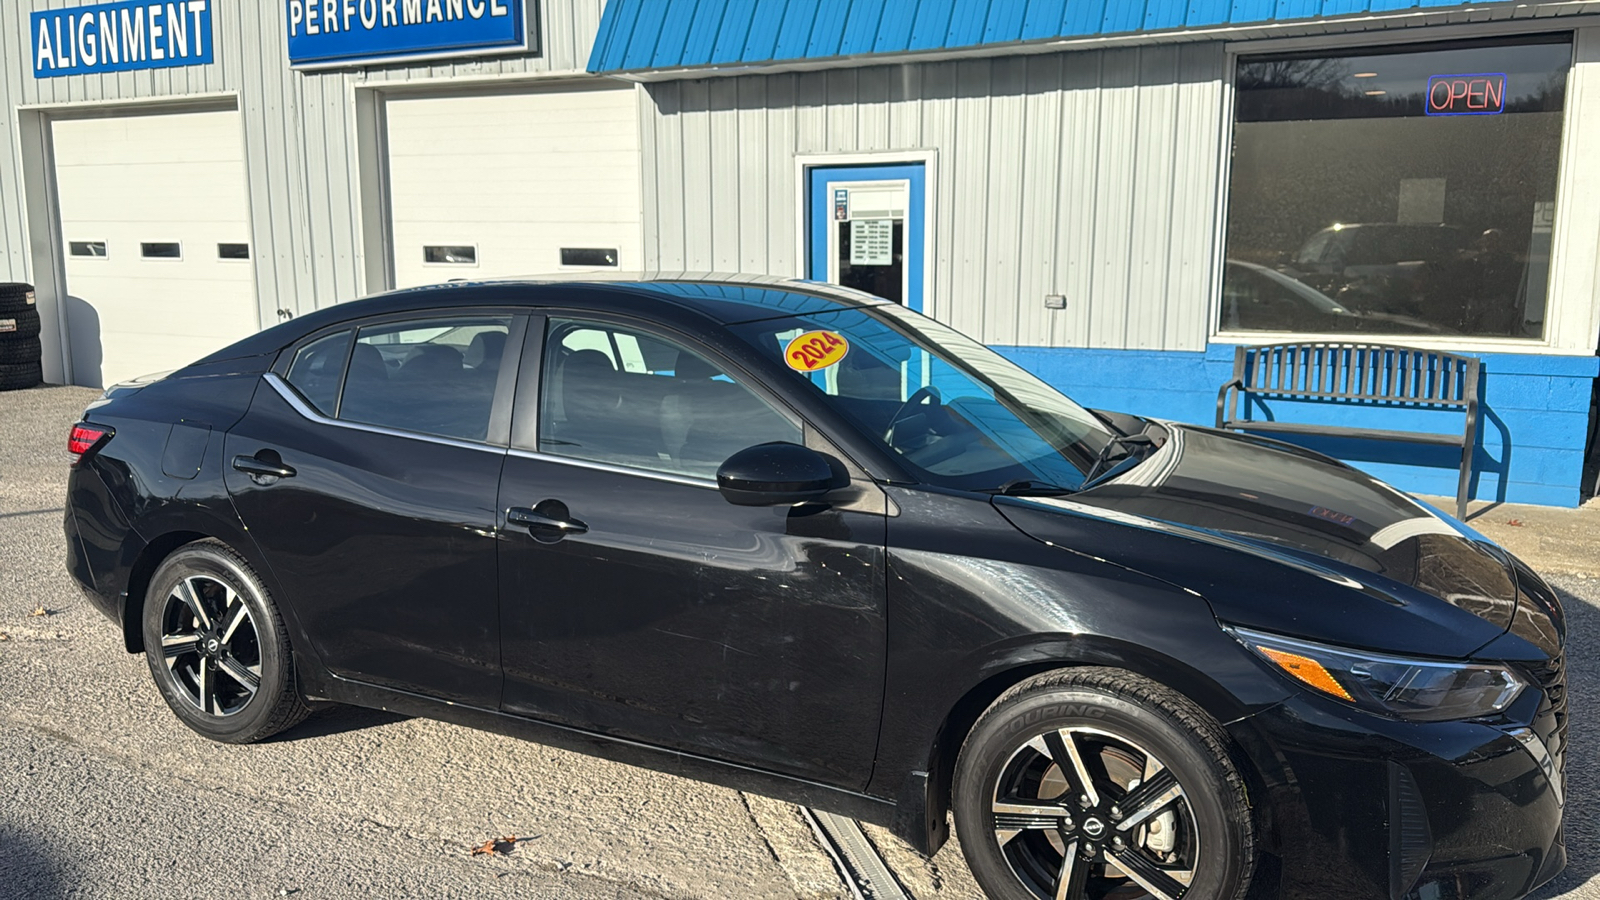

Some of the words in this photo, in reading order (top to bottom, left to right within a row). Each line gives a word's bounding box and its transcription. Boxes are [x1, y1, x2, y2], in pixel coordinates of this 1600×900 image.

[36, 1, 207, 70] ALIGNMENT
[1429, 79, 1503, 110] OPEN
[791, 331, 844, 369] 2024
[996, 704, 1106, 738] TOURING
